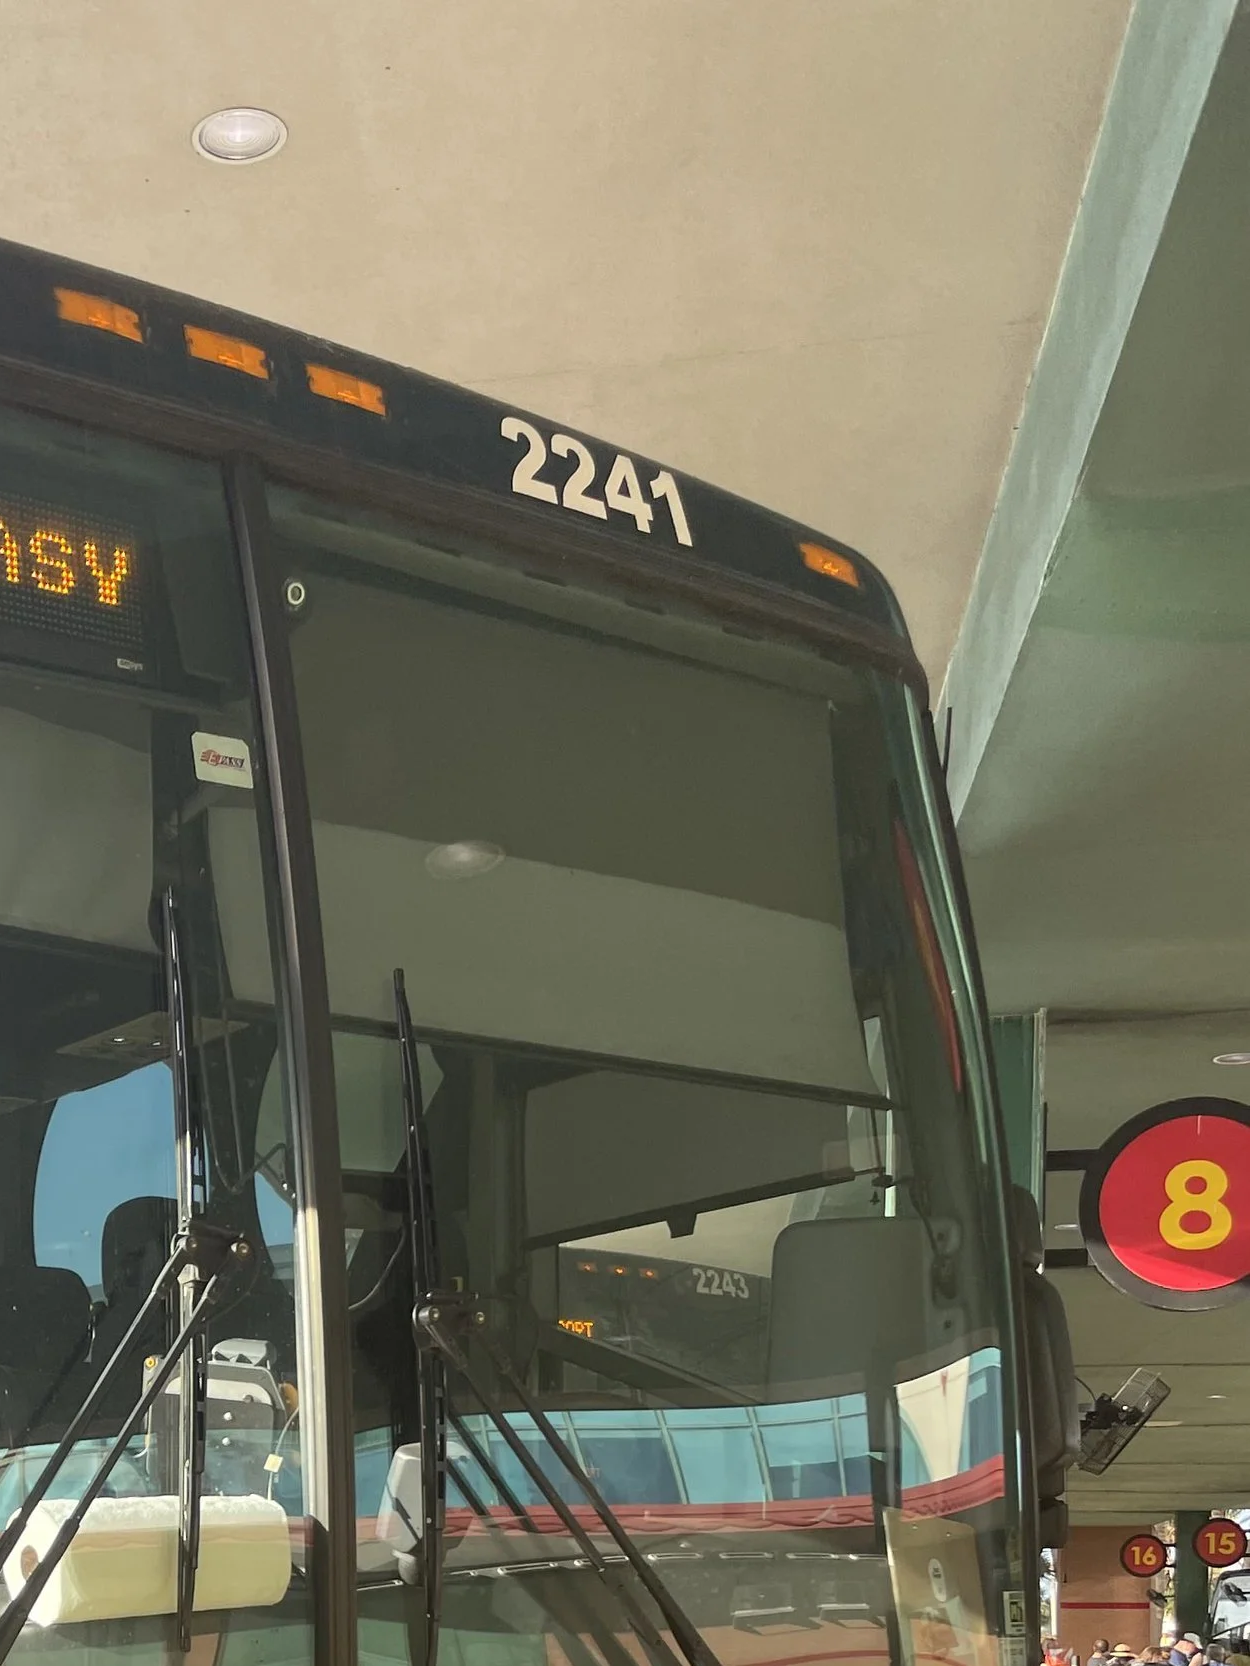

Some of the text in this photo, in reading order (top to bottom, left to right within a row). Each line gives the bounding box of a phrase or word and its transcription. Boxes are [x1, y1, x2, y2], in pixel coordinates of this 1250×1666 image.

[500, 416, 693, 547] 2241
[1158, 1159, 1233, 1250] 8
[692, 1267, 749, 1299] 2243
[1130, 1545, 1157, 1566] 16
[1204, 1532, 1237, 1555] 15
